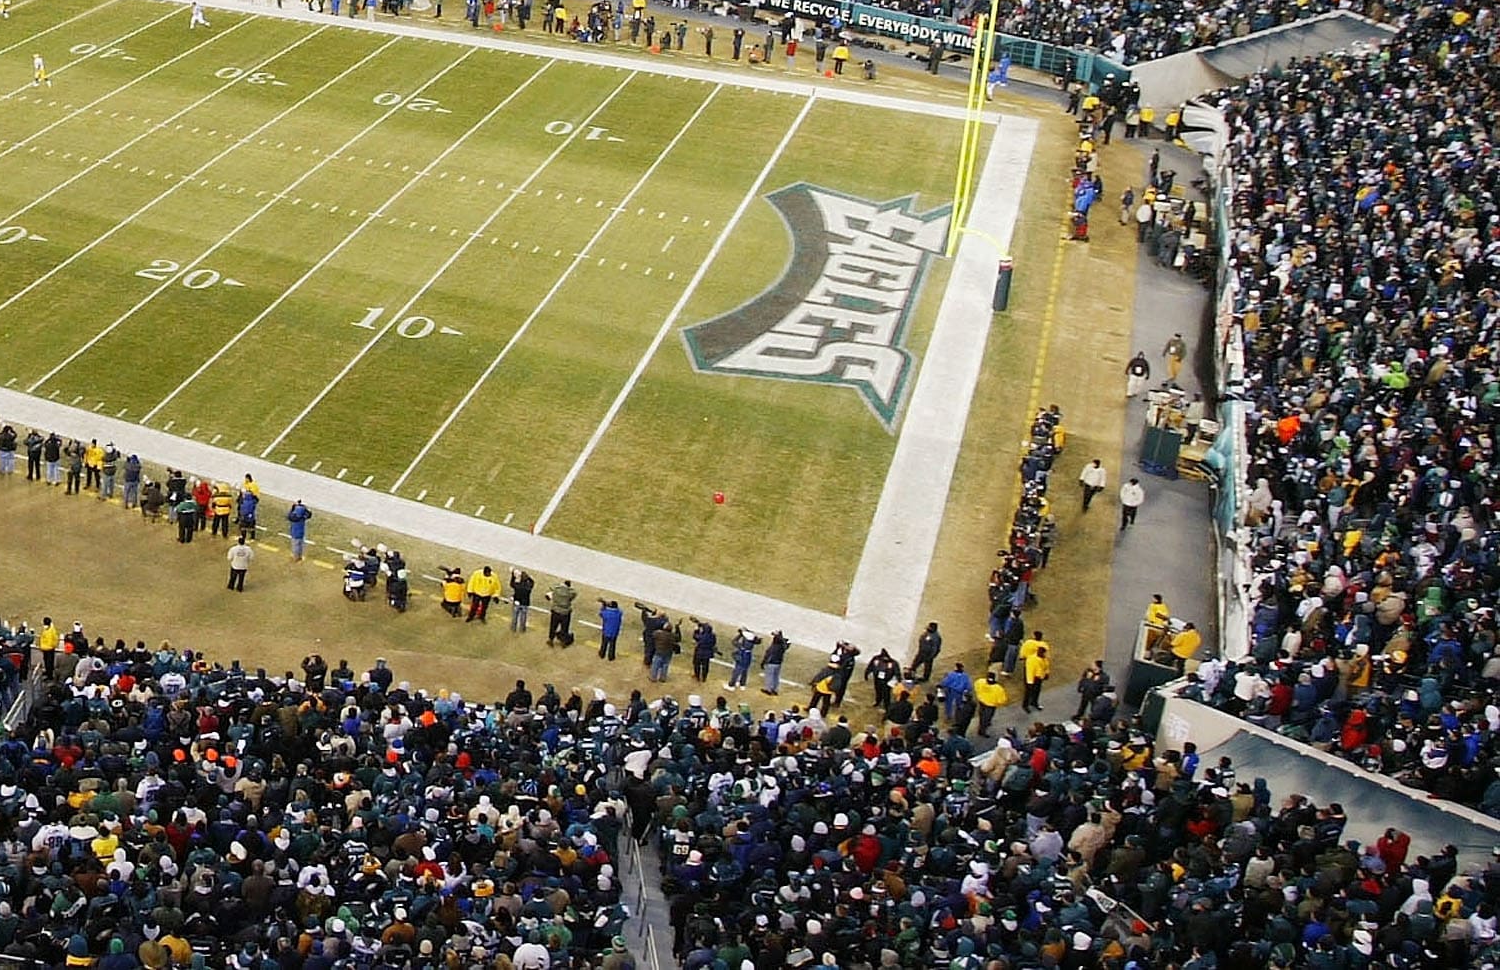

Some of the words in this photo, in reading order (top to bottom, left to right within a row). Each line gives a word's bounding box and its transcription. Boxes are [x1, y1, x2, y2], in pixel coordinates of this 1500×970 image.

[793, 0, 854, 24] RECYCLE,
[858, 13, 938, 41] EVERYBODY
[134, 259, 220, 289] 20
[711, 188, 950, 403] EAGLES
[349, 307, 435, 338] 10
